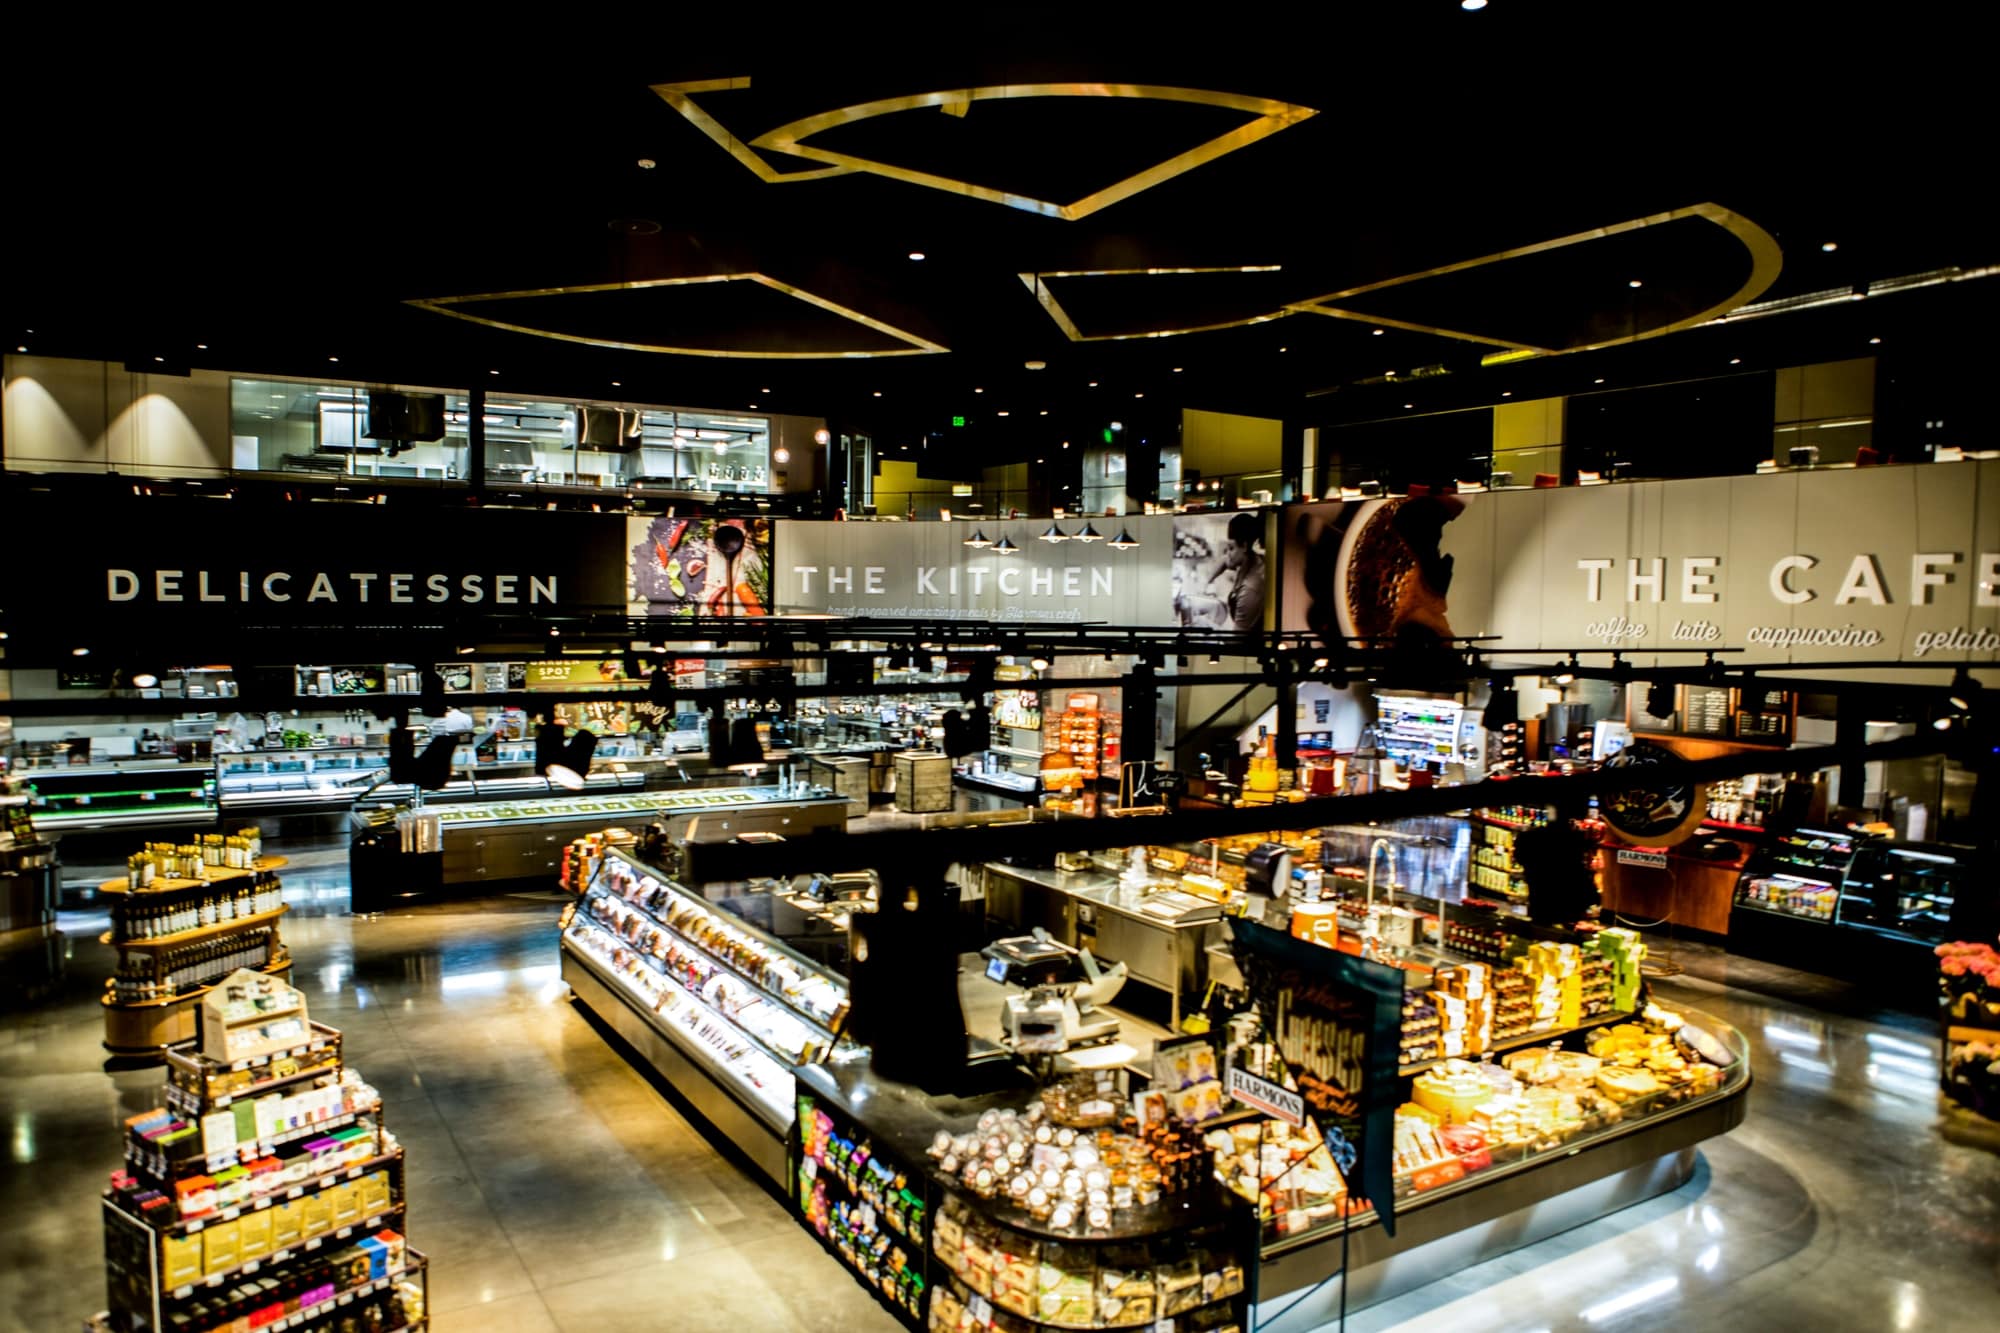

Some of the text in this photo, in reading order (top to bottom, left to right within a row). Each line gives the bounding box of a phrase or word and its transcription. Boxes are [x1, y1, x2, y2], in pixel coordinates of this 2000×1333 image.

[107, 569, 558, 604] DELICATESSEN
[793, 566, 1113, 597] THE KITCHEN
[1577, 556, 1722, 604] THE
[1586, 616, 1649, 645] coffee
[1672, 619, 1722, 641] latte
[1746, 623, 1885, 648] cappuccino
[1914, 625, 2000, 657] gelato
[1232, 1071, 1300, 1115] HARMONS
